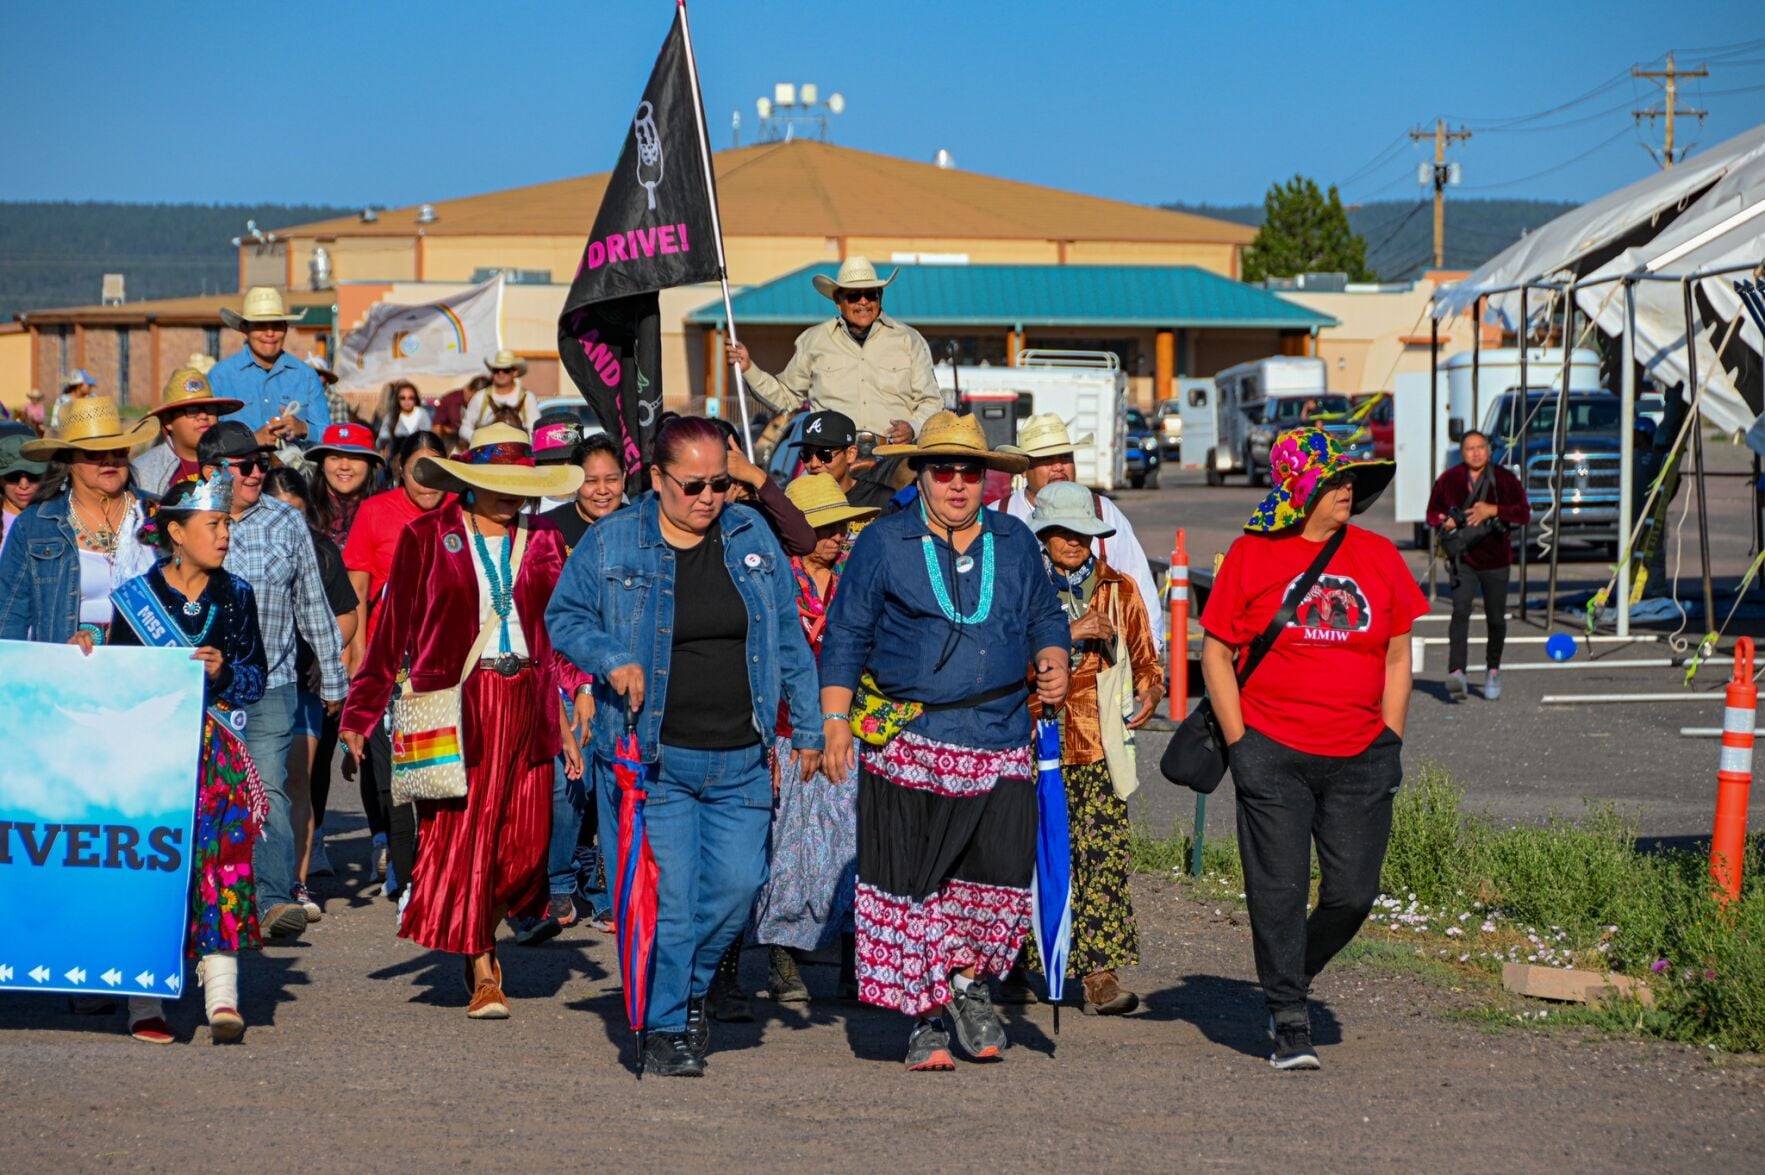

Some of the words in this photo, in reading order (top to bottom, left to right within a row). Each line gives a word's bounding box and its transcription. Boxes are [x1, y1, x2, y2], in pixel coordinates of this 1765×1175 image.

[588, 223, 690, 270] DRIVE!
[578, 328, 621, 387] AND
[136, 604, 166, 640] MISS
[1303, 628, 1350, 641] MMIW
